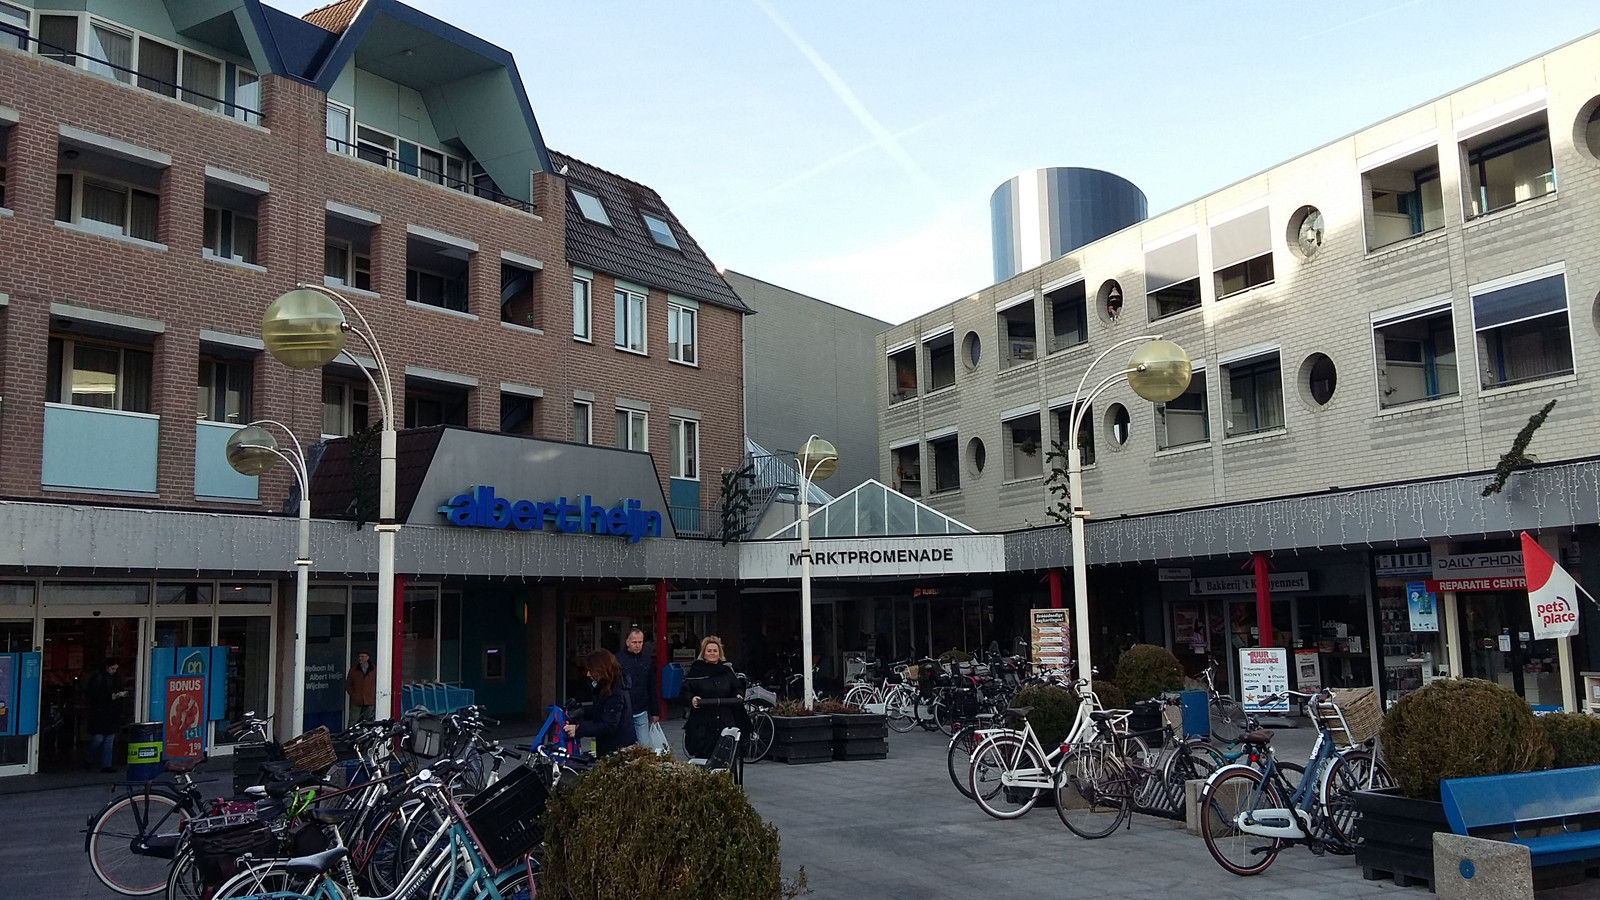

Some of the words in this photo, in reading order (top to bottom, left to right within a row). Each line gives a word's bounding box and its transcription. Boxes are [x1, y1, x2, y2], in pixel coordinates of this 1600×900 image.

[1438, 557, 1475, 569] DAILY
[1478, 554, 1525, 567] PHON
[1206, 579, 1241, 591] Bakkerij
[1251, 577, 1305, 590] Kyennest
[1439, 579, 1491, 591] REPARATIE
[1492, 577, 1527, 589] CENTR
[1537, 601, 1564, 617] pets
[1543, 612, 1576, 628] place
[169, 680, 201, 692] BONUS
